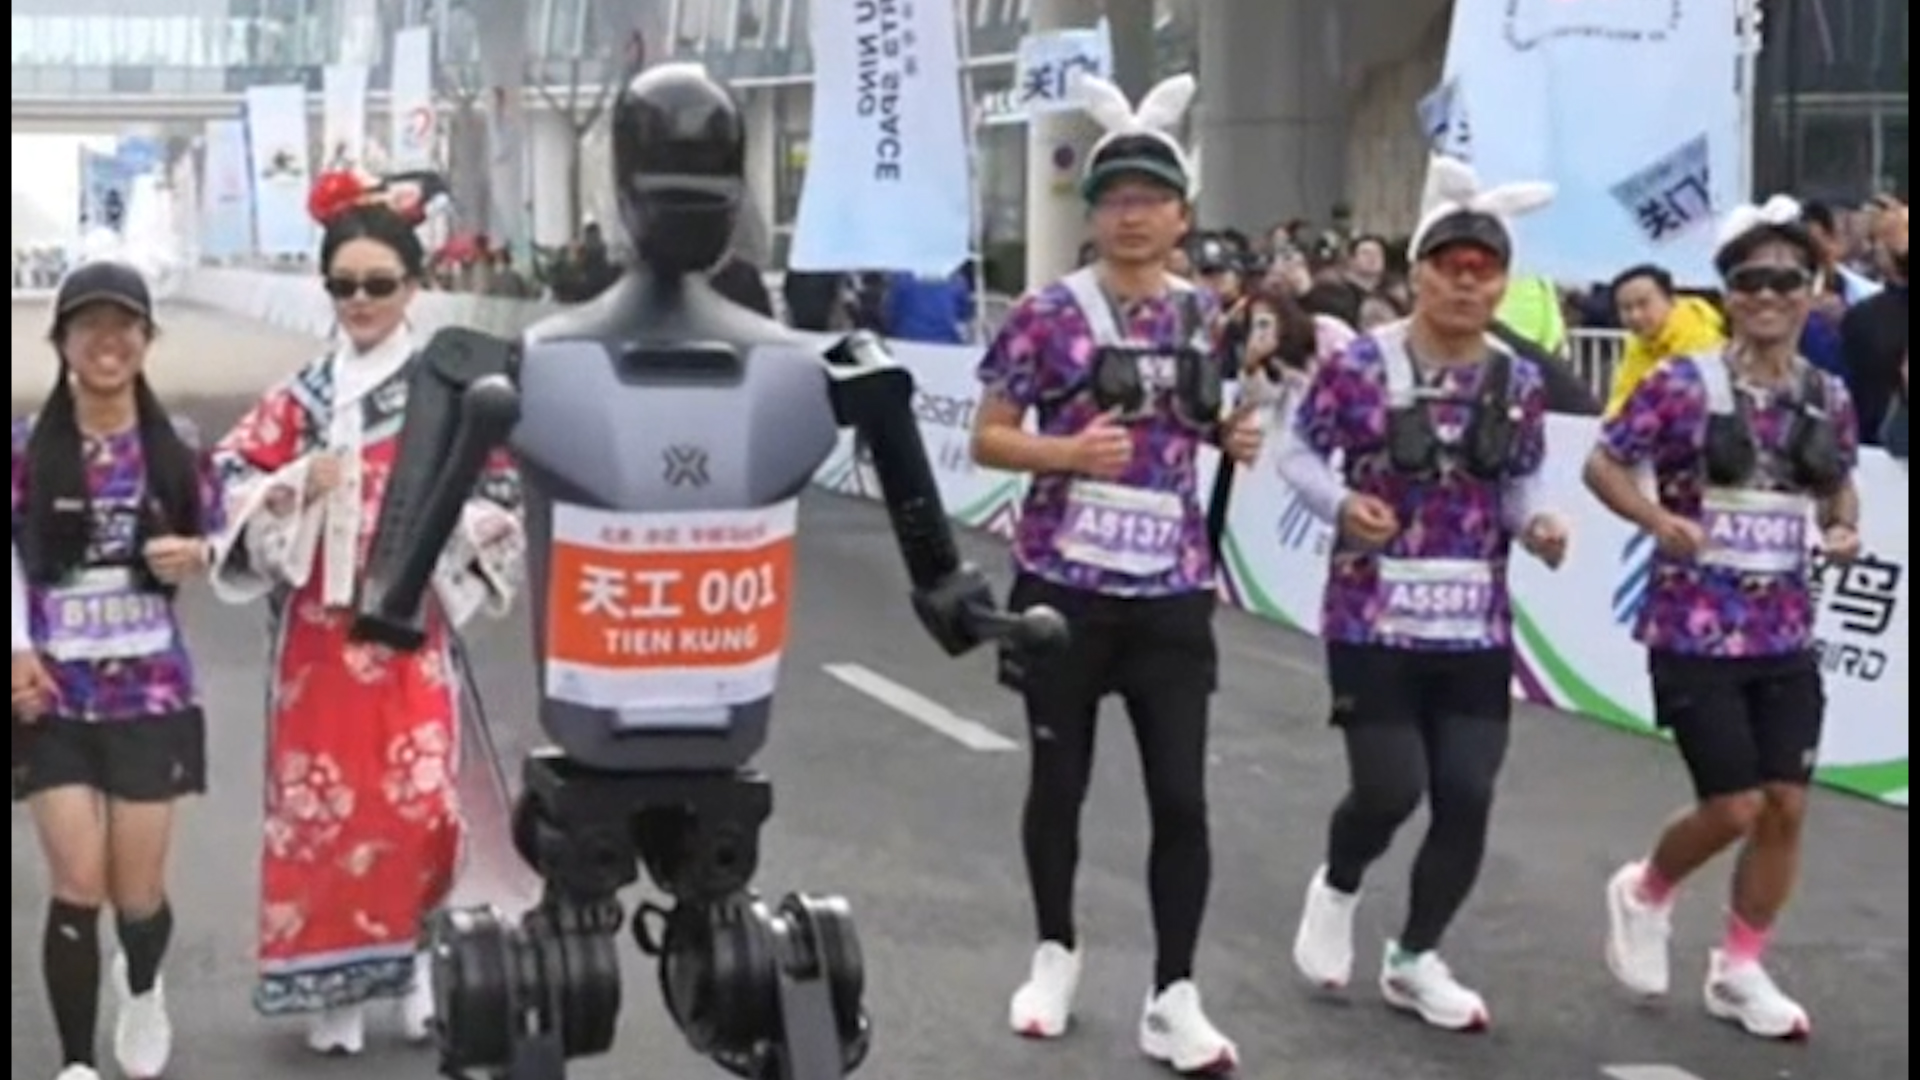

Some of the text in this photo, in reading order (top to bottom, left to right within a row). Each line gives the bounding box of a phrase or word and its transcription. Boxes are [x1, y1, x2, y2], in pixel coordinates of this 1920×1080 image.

[577, 562, 778, 620] 天工 001
[602, 623, 758, 655] TIEN KUNG
